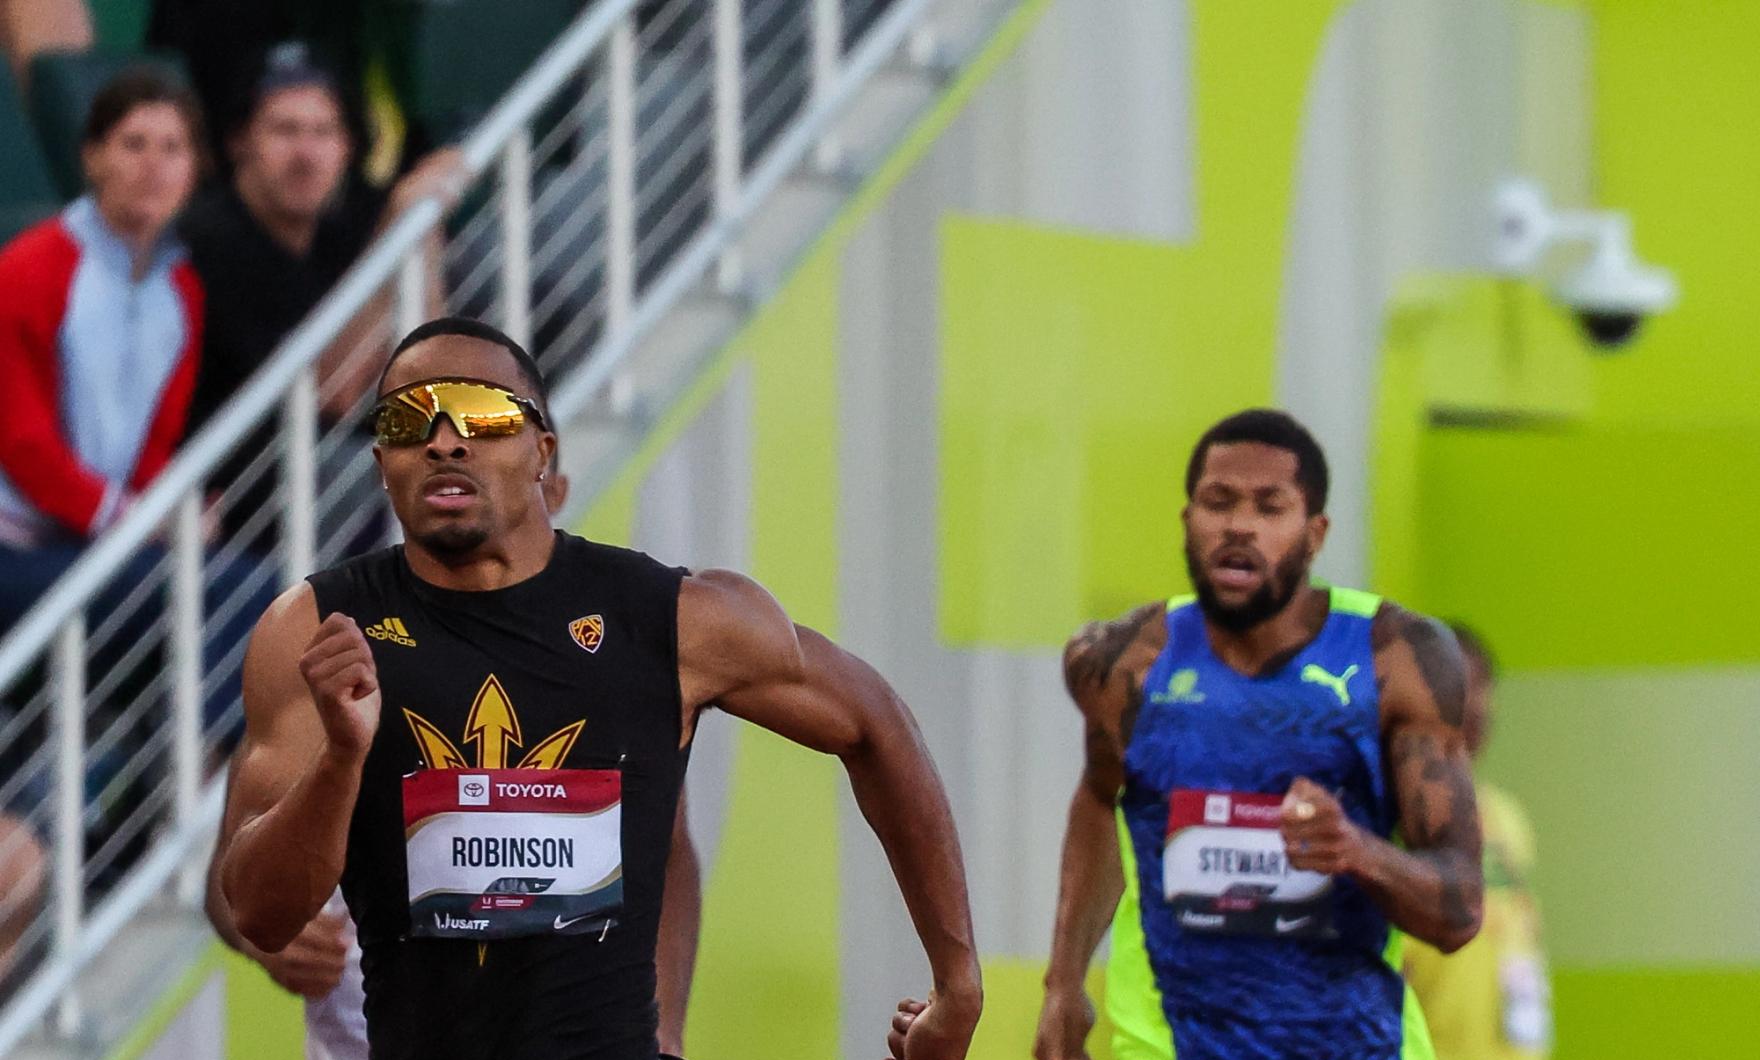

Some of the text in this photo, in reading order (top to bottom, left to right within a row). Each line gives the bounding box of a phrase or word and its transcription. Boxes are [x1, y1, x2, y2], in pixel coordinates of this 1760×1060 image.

[365, 627, 417, 647] adidas
[580, 631, 598, 646] 12
[495, 783, 567, 799] TOYOTA
[452, 836, 574, 869] ROBINSON
[450, 919, 490, 931] USATF
